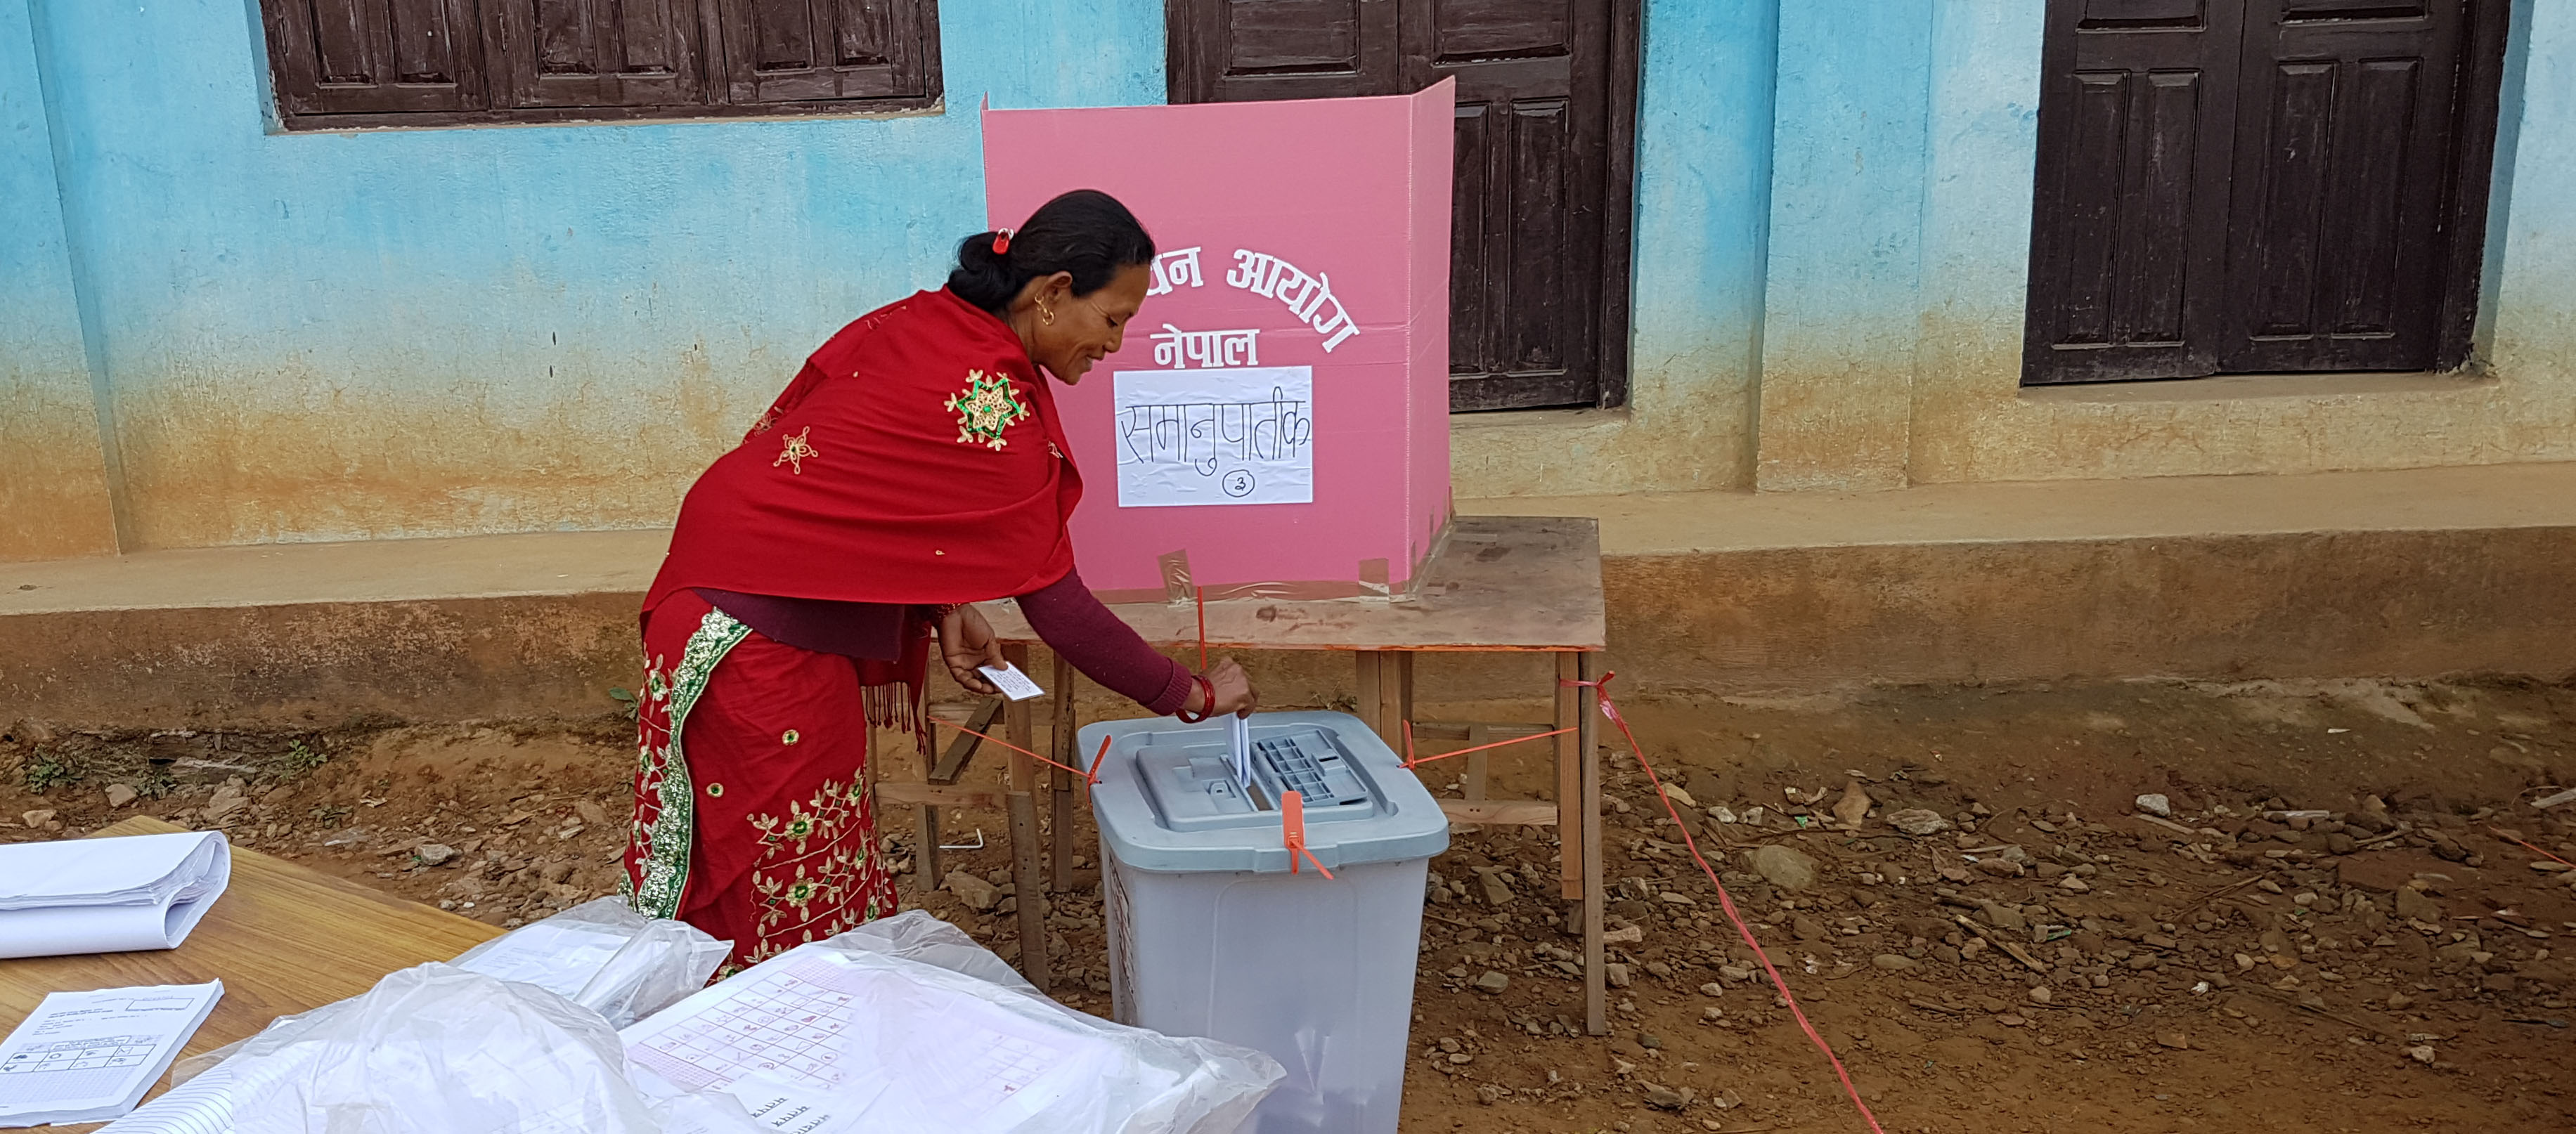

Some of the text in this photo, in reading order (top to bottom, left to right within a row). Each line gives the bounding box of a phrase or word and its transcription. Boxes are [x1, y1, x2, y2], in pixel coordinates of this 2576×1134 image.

[1226, 249, 1361, 353] आयोग
[1149, 323, 1260, 370] नेपाल
[771, 1106, 810, 1127] मतपत्र
